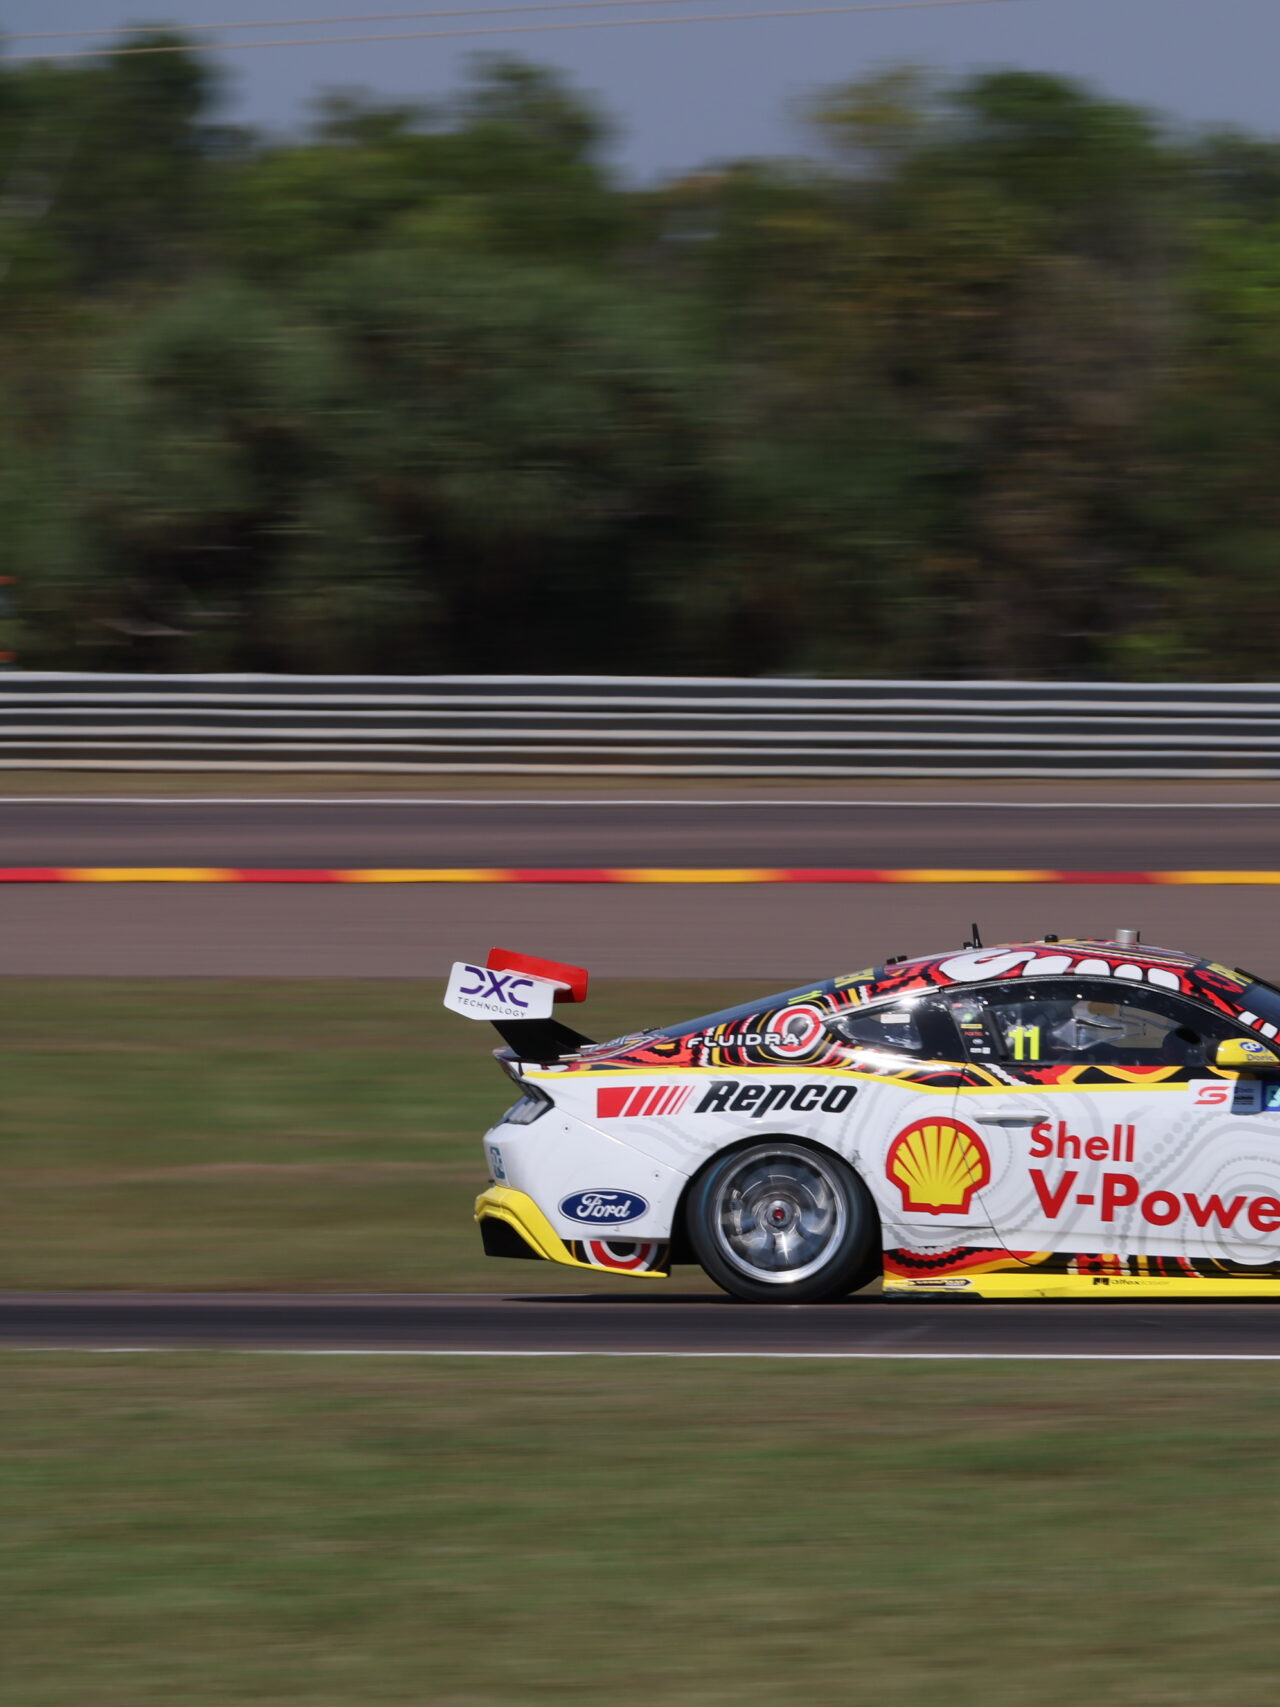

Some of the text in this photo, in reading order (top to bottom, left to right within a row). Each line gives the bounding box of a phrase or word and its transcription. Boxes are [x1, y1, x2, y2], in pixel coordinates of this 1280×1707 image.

[460, 966, 534, 1008] DXC
[457, 997, 527, 1018] TECHNOLOGY
[687, 1033, 800, 1048] FLUIDRA
[1008, 1027, 1039, 1060] 11
[694, 1081, 858, 1118] Repco
[1029, 1120, 1135, 1162] Shell
[576, 1193, 632, 1217] Ford
